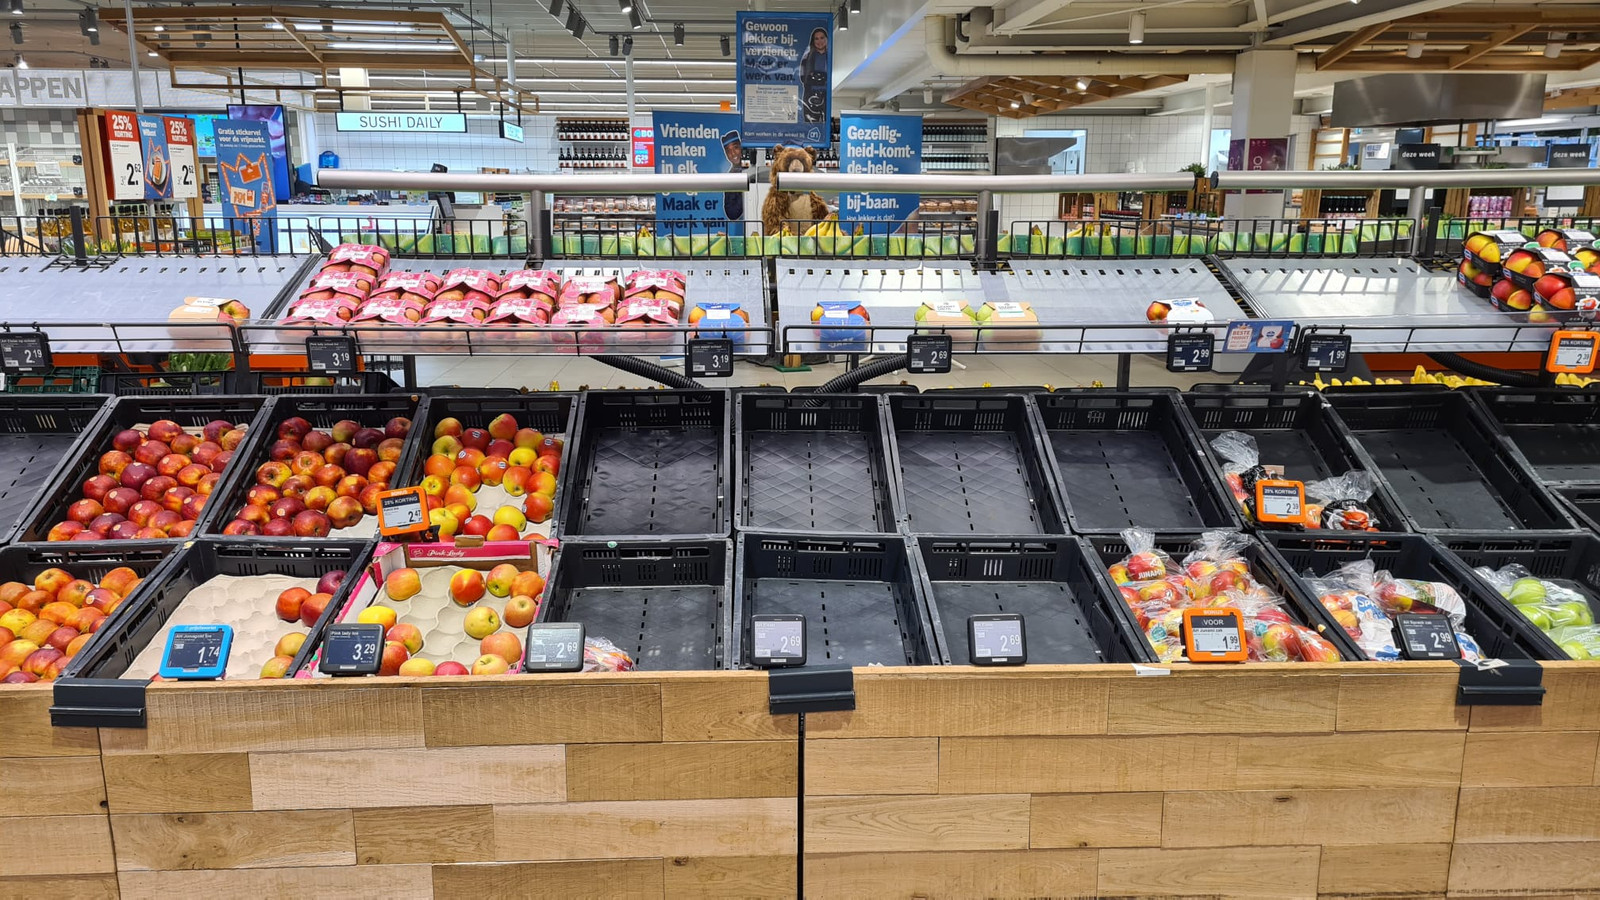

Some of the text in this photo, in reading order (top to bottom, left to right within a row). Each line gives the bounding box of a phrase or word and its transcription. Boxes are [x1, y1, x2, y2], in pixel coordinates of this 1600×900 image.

[746, 22, 788, 32] Gewoon
[745, 33, 798, 46] lekker bij-
[746, 46, 798, 56] verdienen.
[0, 77, 82, 98] APPEN
[112, 115, 133, 131] 25%
[170, 120, 187, 135] 25%
[359, 116, 443, 129] SUSHI DAILY
[660, 124, 720, 139] Vrienden
[847, 126, 902, 144] Gezellig-
[661, 142, 706, 156] maken
[847, 142, 916, 158] heid-komt-
[662, 160, 698, 174] in elk
[847, 160, 899, 174] de-hele-
[662, 196, 718, 210] Maak er
[846, 194, 900, 212] bij-baan.
[662, 214, 698, 228] werk
[24, 349, 42, 364] 2.19
[332, 352, 350, 366] 3.19
[712, 354, 729, 368] 3.19
[930, 350, 948, 364] 2.69
[1192, 348, 1210, 363] 2.99
[1328, 350, 1346, 364] 1.99
[395, 496, 418, 504] KORTING
[446, 550, 466, 558] Lady
[780, 635, 801, 653] 2.69
[1000, 634, 1020, 652] 2.69
[1222, 636, 1238, 650] 1.99
[1430, 632, 1451, 648] 2.99
[198, 646, 220, 664] 1.74
[352, 643, 376, 660] 3.29
[556, 642, 578, 658] 2.69
